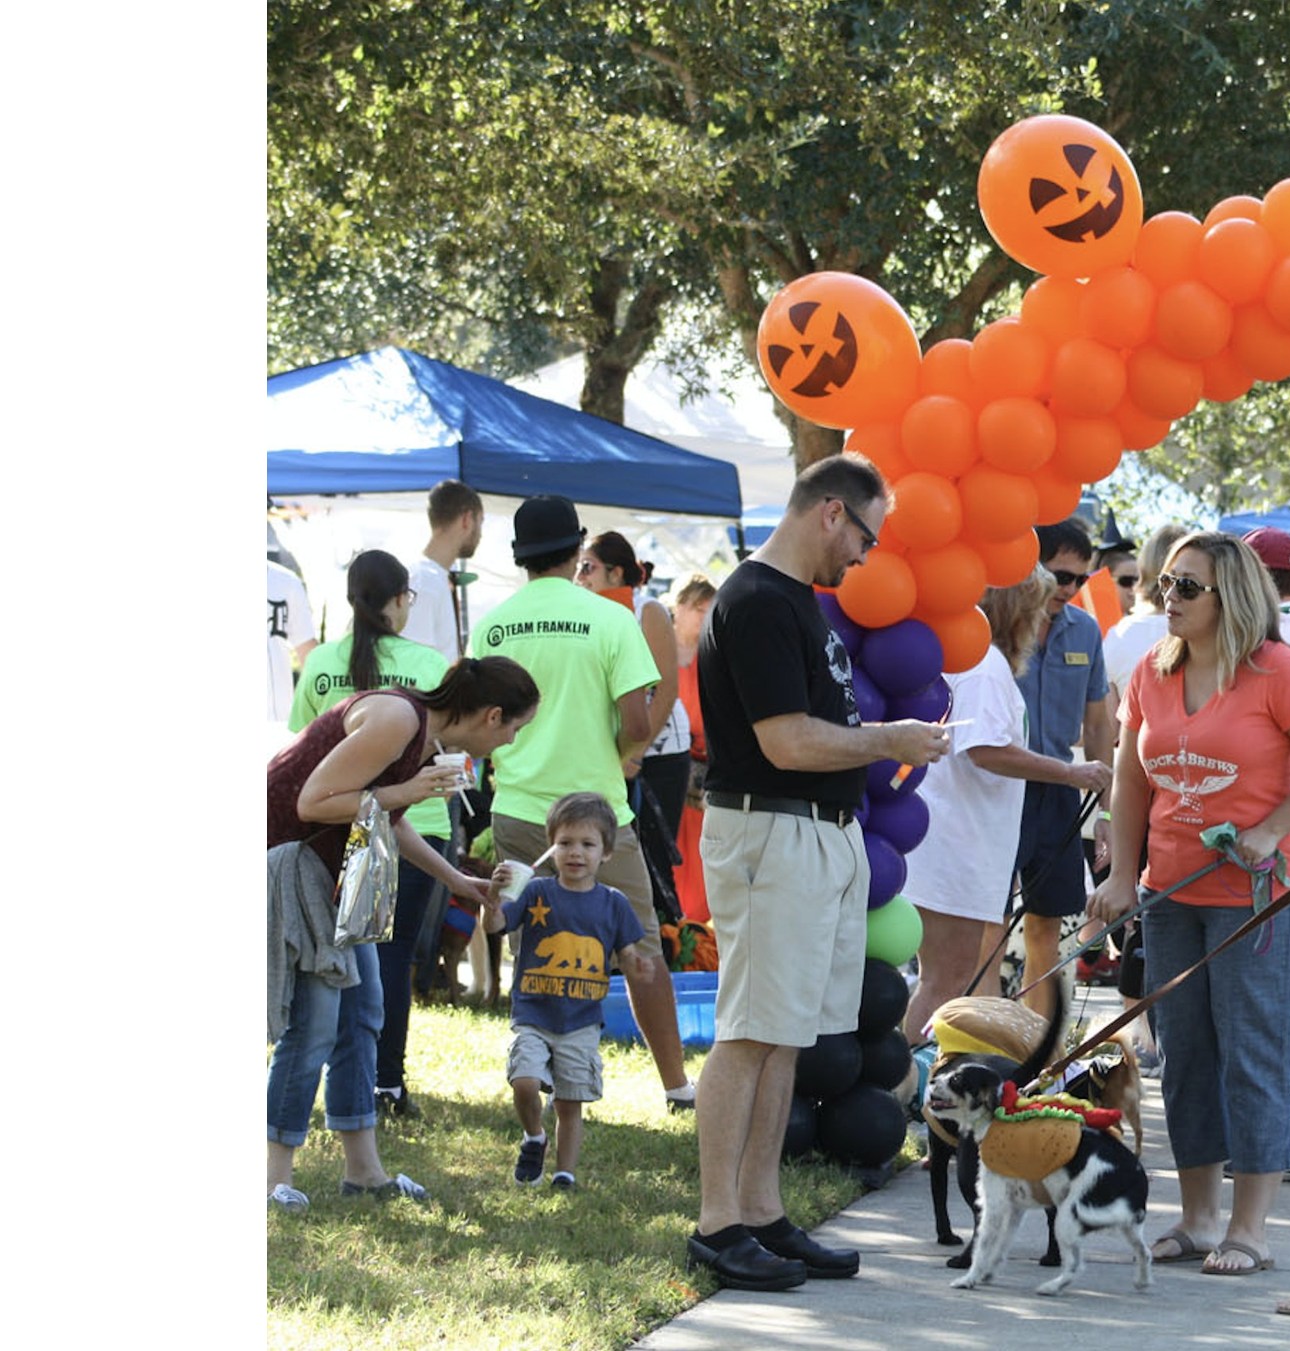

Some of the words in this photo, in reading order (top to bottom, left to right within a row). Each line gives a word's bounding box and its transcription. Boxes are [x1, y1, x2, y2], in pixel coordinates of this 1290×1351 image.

[505, 621, 534, 637] TEAM
[537, 620, 590, 636] FRANKLIN
[332, 674, 355, 688] TEA
[1187, 752, 1239, 775] BREWS
